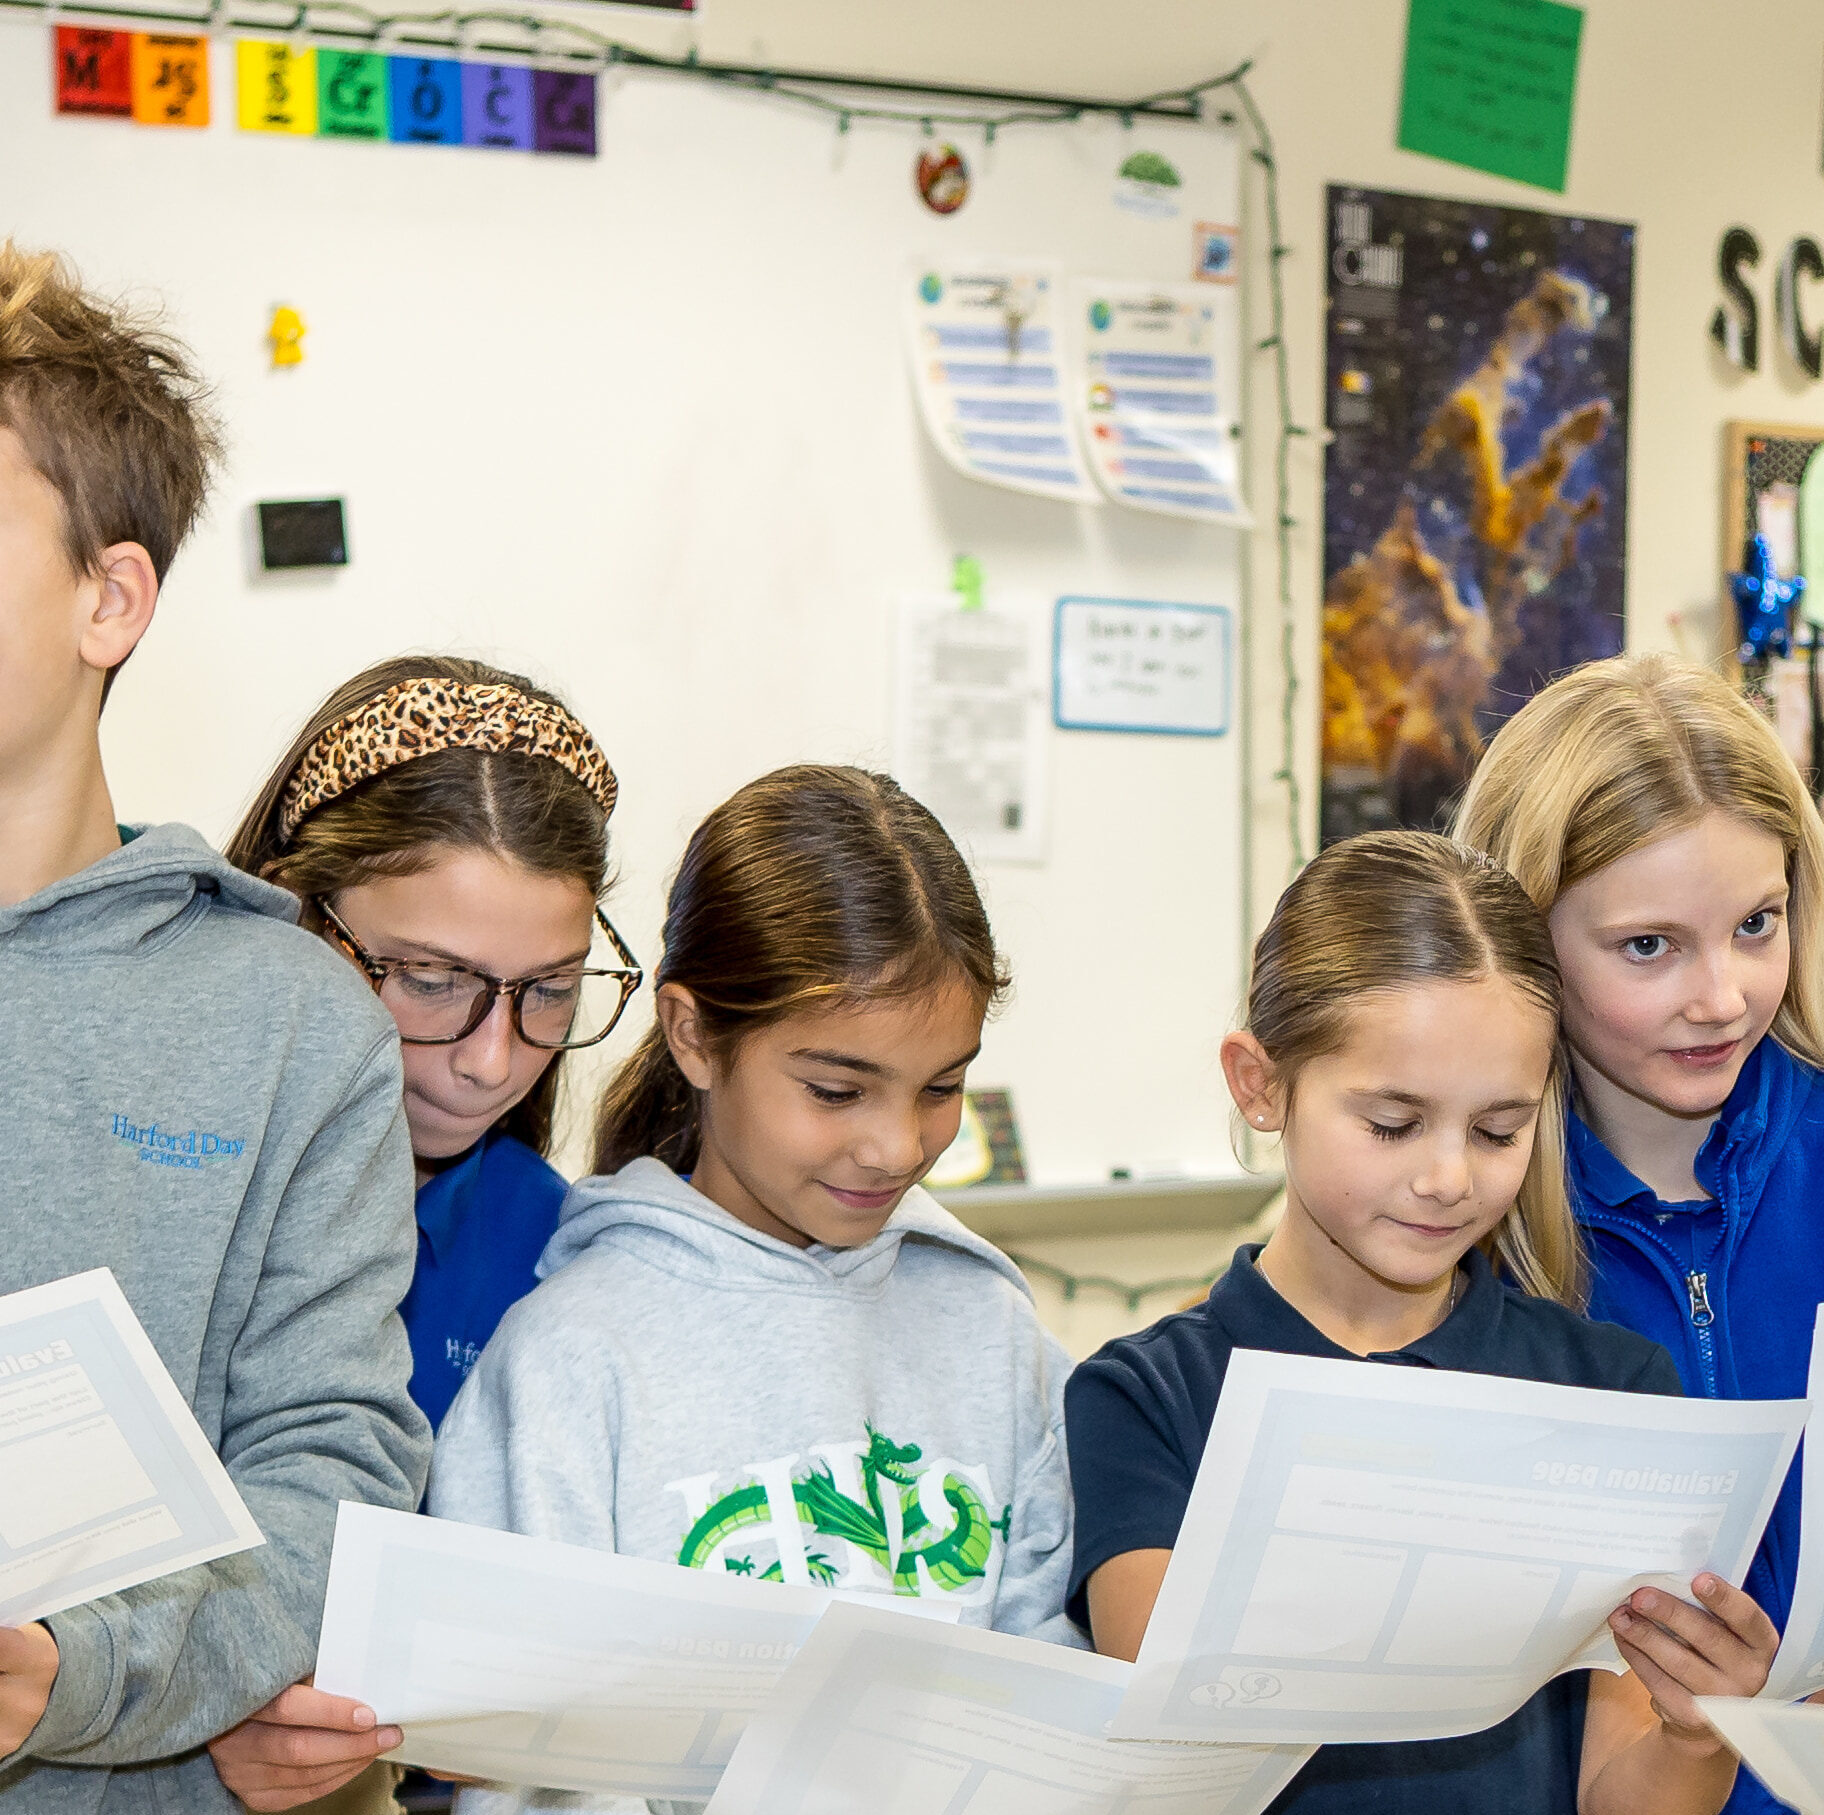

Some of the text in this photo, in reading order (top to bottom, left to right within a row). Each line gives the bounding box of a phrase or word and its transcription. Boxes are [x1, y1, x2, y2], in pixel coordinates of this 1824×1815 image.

[111, 1112, 246, 1161] Harford Day
[139, 1147, 204, 1170] SCHOOL
